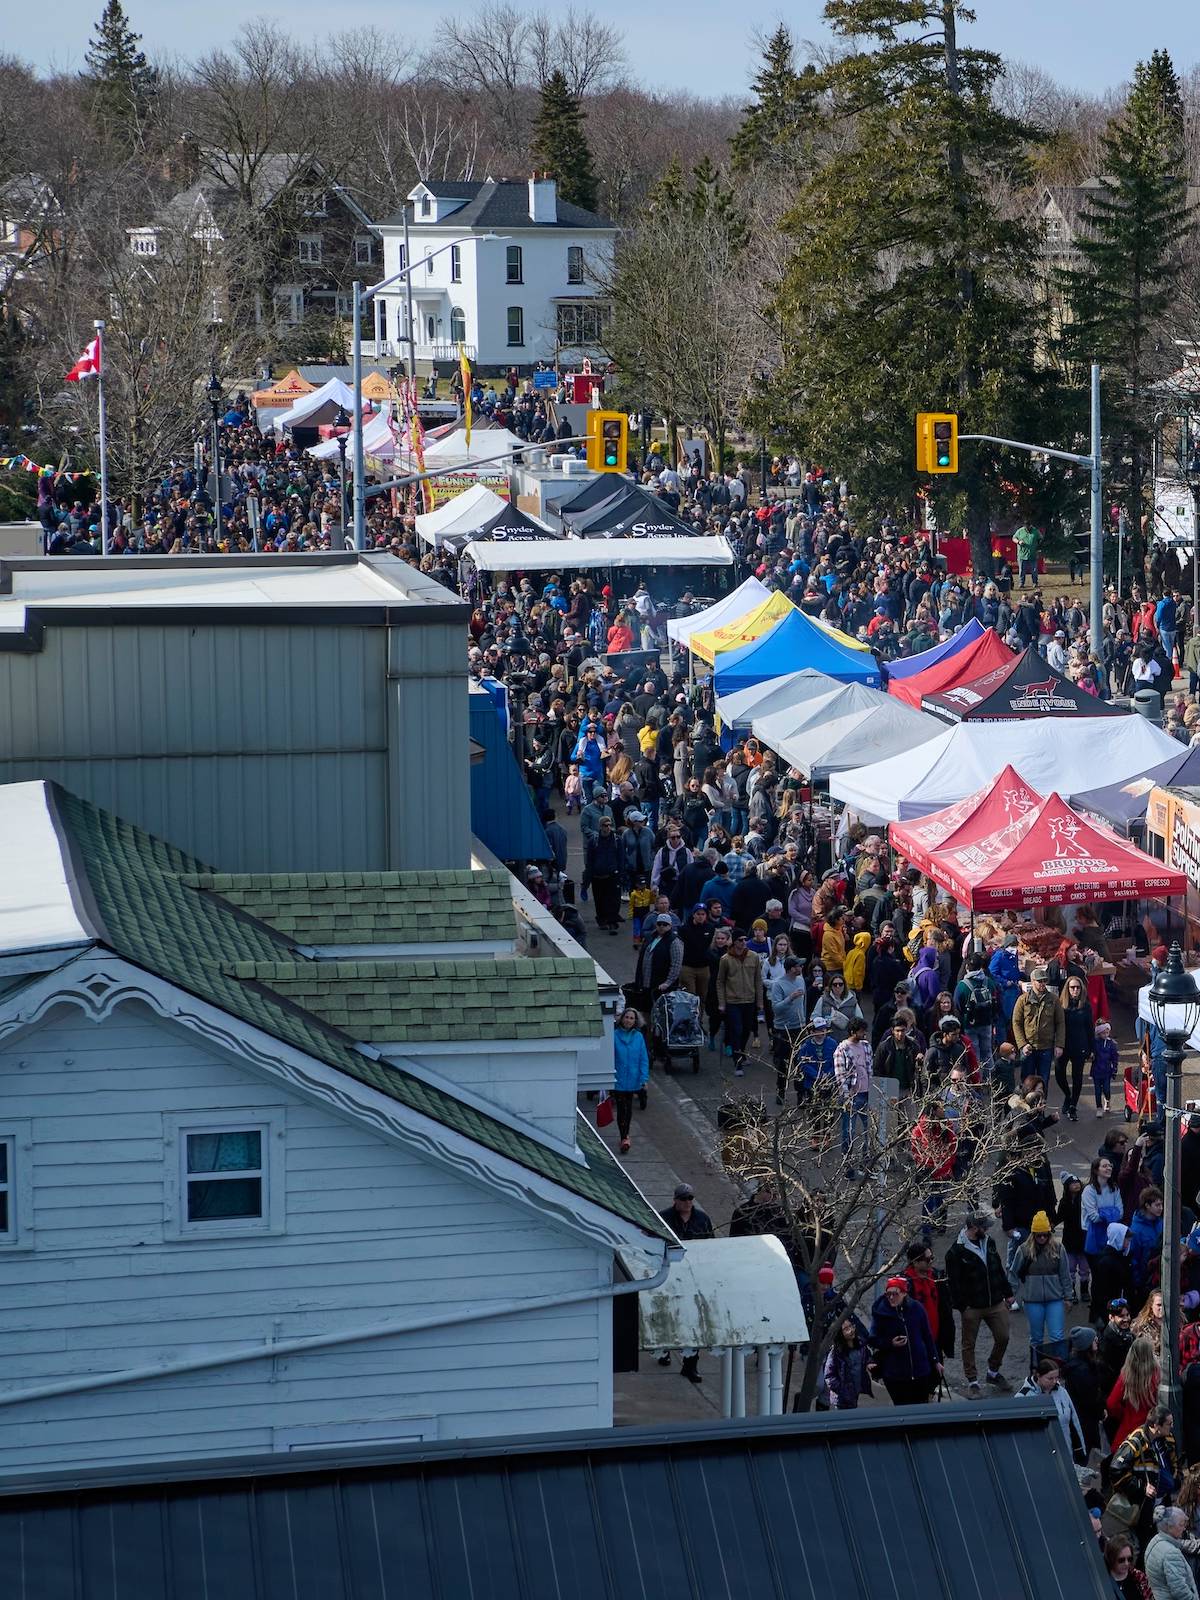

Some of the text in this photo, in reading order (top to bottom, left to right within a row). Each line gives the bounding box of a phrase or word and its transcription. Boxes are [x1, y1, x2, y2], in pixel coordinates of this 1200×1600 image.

[492, 525, 535, 539] Snyder
[632, 522, 674, 536] Snyder
[1010, 698, 1078, 709] ENDEAVOUR
[1042, 859, 1108, 870] BRUNO'S
[990, 879, 1170, 898] COOKIES PREPARED FOODS CATERING HOT TABLE ESPRESSO
[1023, 895, 1042, 904] BREADS
[1049, 894, 1062, 903] BUNS
